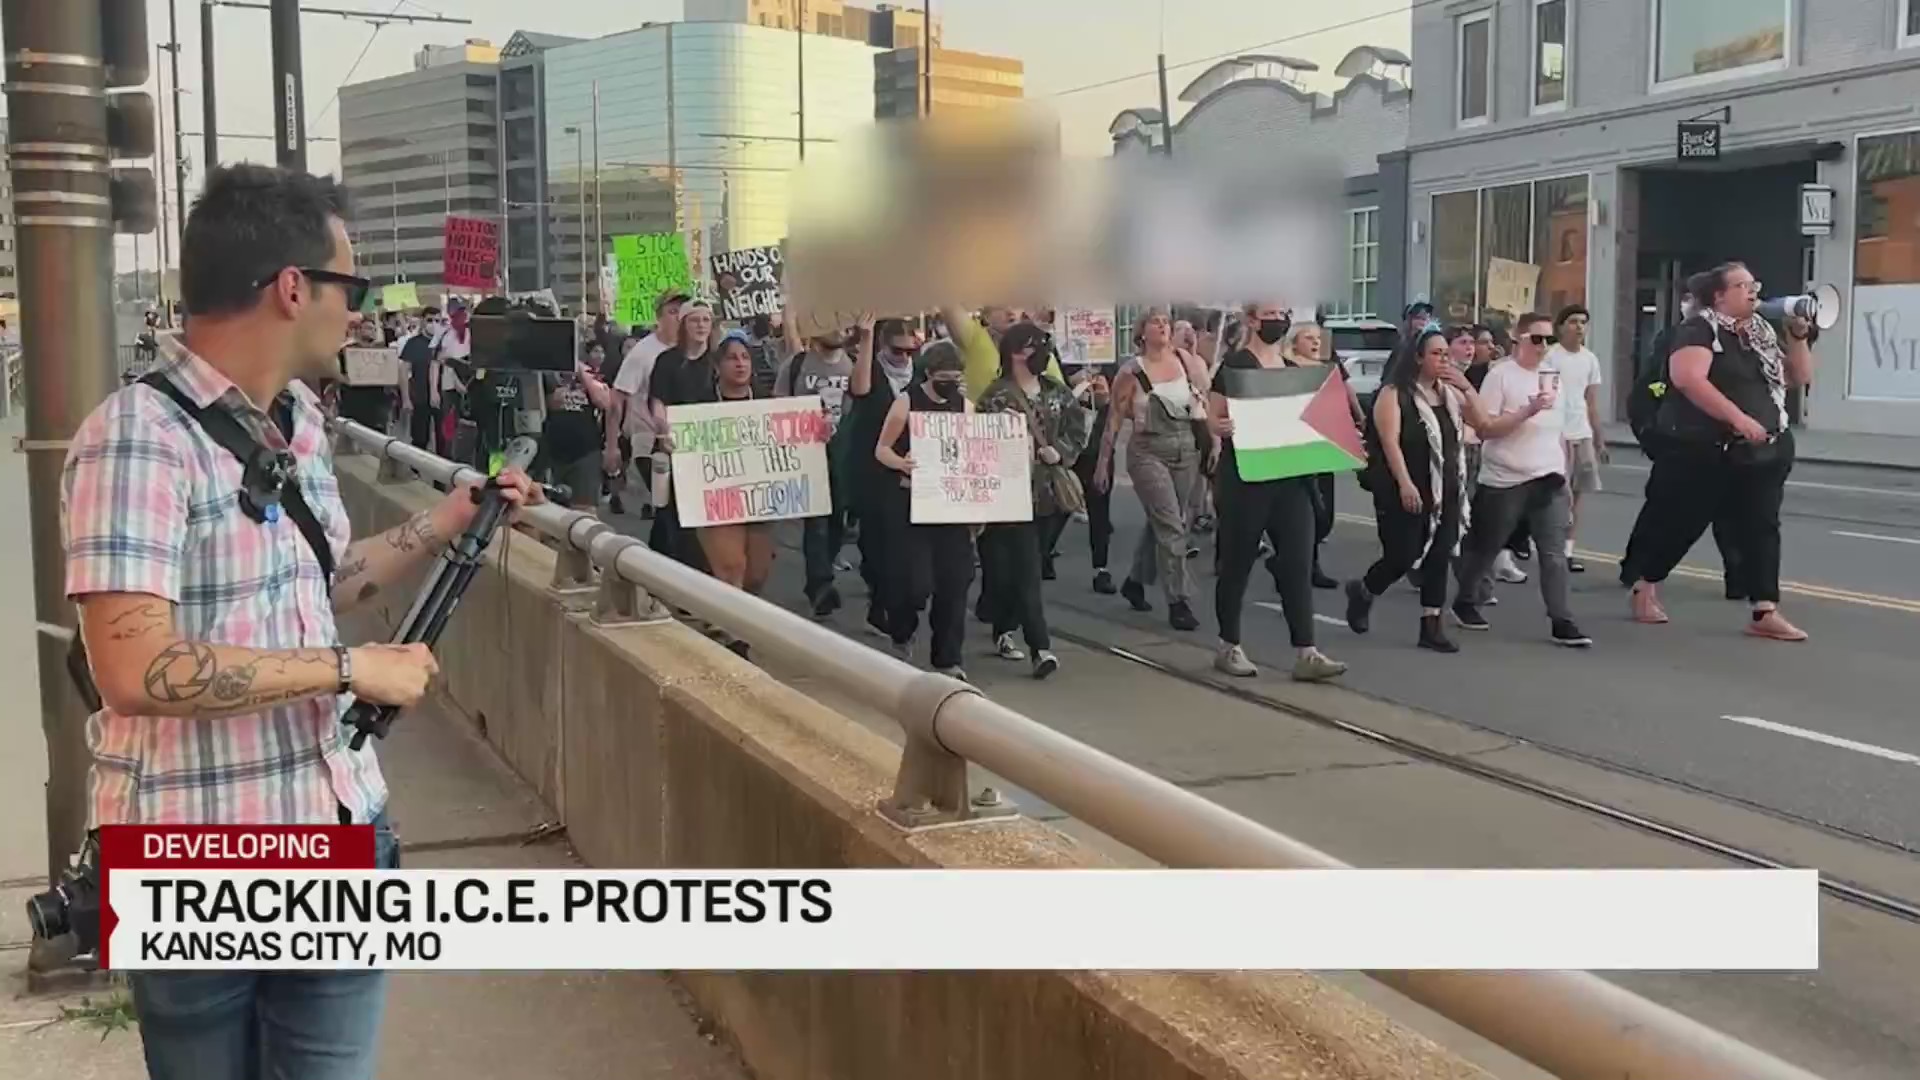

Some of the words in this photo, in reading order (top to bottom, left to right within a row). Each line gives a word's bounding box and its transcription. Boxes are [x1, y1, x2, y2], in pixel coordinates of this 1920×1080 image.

[1682, 145, 1717, 157] Fiction
[713, 248, 769, 274] HANDS
[741, 265, 777, 284] OUR
[671, 410, 831, 452] IMMIGRATION
[702, 448, 746, 483] BUILT
[758, 443, 802, 474] THIS
[703, 474, 811, 521] NATION
